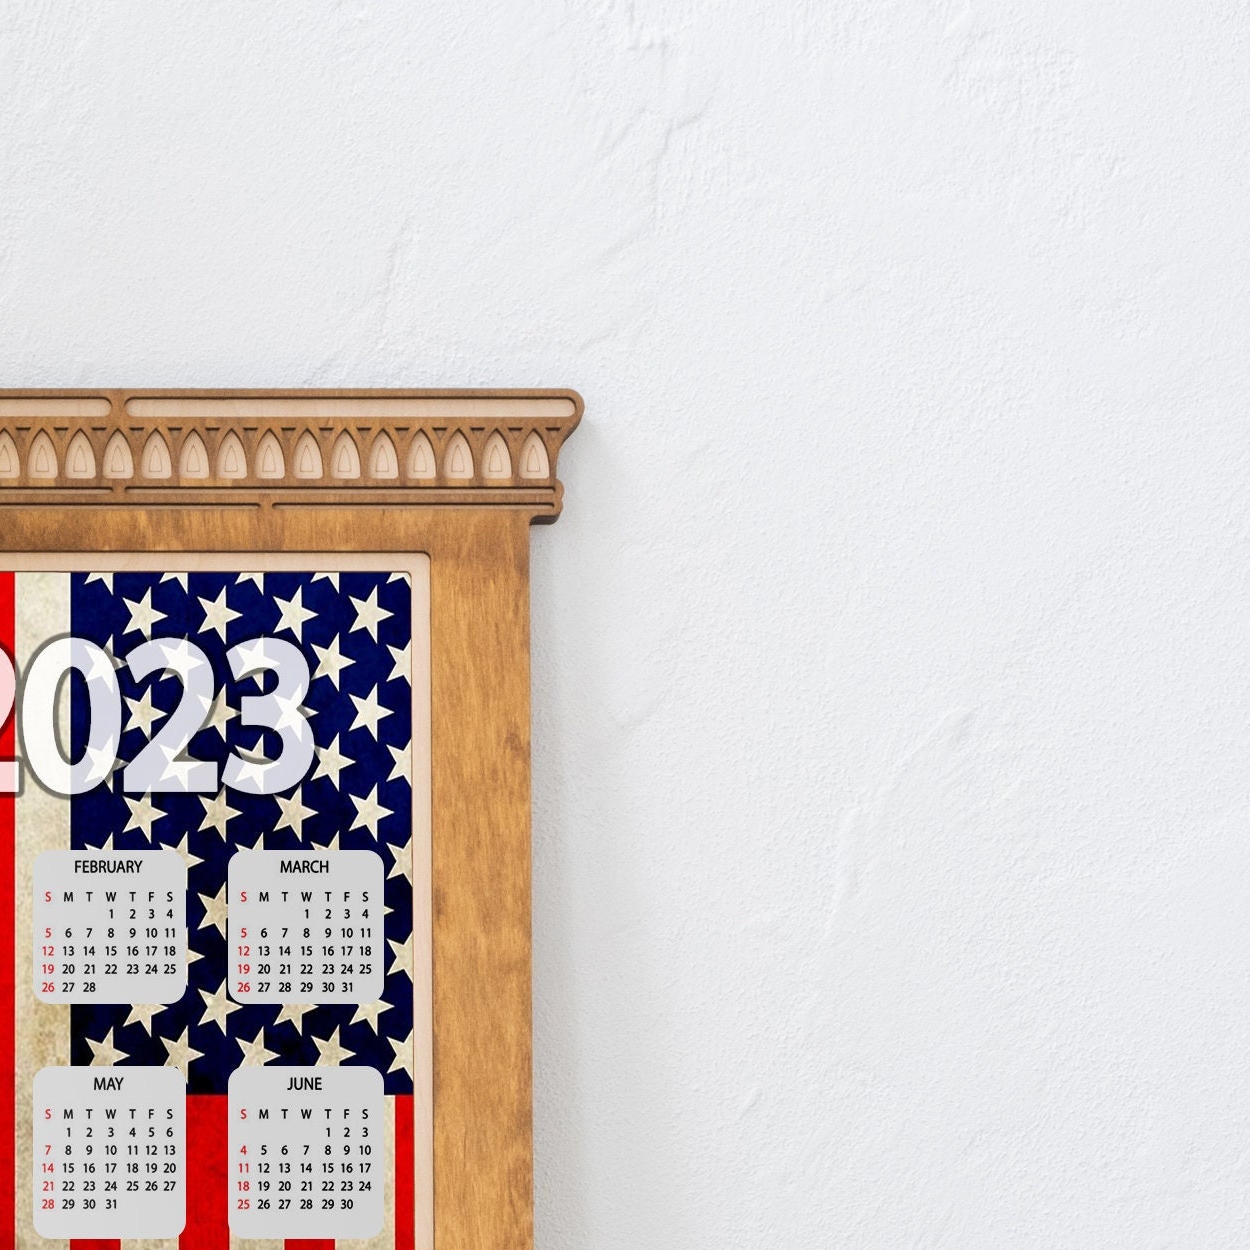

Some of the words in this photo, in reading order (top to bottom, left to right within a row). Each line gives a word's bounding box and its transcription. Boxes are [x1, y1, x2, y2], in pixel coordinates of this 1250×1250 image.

[74, 859, 144, 874] FEBRUARY
[279, 859, 330, 874] MARCH
[129, 908, 137, 920] 2
[148, 908, 155, 920] 3
[166, 908, 174, 920] 4
[237, 945, 250, 957] 12
[257, 945, 271, 957] 13
[278, 945, 292, 957] 14
[300, 945, 313, 957] 15
[321, 945, 335, 957] 16
[340, 945, 354, 957] 17
[359, 945, 372, 957] 18
[42, 963, 55, 975] 19
[61, 963, 76, 975] 20
[83, 963, 96, 975] 21
[104, 963, 118, 975] 22
[126, 963, 140, 975] 23
[144, 963, 159, 975] 24
[163, 963, 177, 975] 25
[237, 981, 251, 993] 26
[257, 981, 271, 993] 27
[278, 981, 292, 993] 28
[299, 981, 314, 993] 29
[321, 981, 336, 993] 30
[341, 981, 353, 993] 31
[93, 1076, 125, 1091] MAY
[286, 1076, 323, 1091] JUNE
[44, 1108, 52, 1120] S
[63, 1108, 74, 1120] M
[85, 1108, 94, 1120] T
[104, 1108, 117, 1120] W
[128, 1108, 137, 1120] T
[148, 1108, 155, 1120] F
[166, 1108, 174, 1120] S
[343, 1126, 351, 1138] 2
[361, 1126, 369, 1138] 3
[238, 1162, 250, 1174] 11
[257, 1162, 271, 1174] 12
[278, 1162, 291, 1174] 13
[299, 1162, 313, 1174] 14
[322, 1162, 335, 1174] 15
[340, 1162, 354, 1174] 16
[358, 1162, 372, 1174] 17
[42, 1180, 54, 1192] 21
[61, 1180, 75, 1192] 22
[82, 1180, 96, 1192] 23
[104, 1180, 118, 1192] 24
[126, 1180, 140, 1192] 25
[144, 1180, 159, 1192] 26
[163, 1180, 177, 1192] 27
